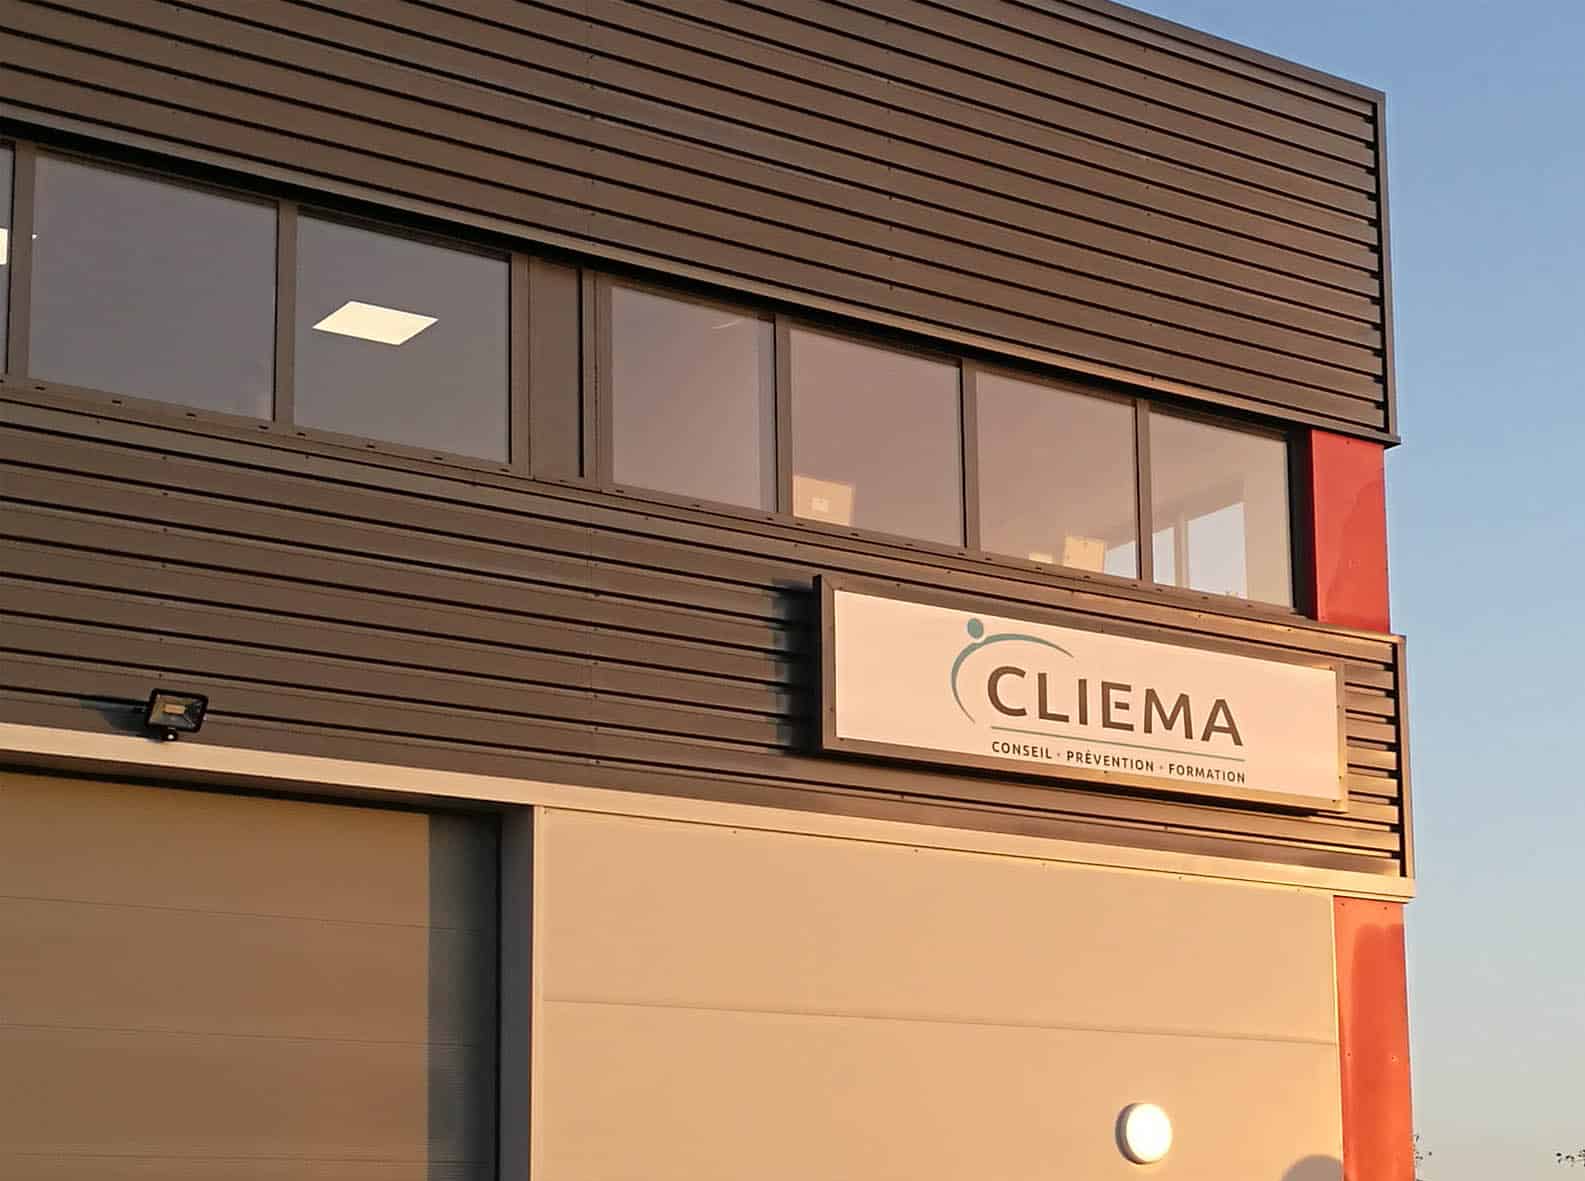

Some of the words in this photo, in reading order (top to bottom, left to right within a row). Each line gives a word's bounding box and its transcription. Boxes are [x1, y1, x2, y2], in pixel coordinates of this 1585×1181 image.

[987, 666, 1243, 746] CLIEMA
[991, 741, 1053, 759] CONSEIL
[1066, 749, 1154, 772] PRÉVENTION
[1168, 763, 1246, 784] FORMATION
